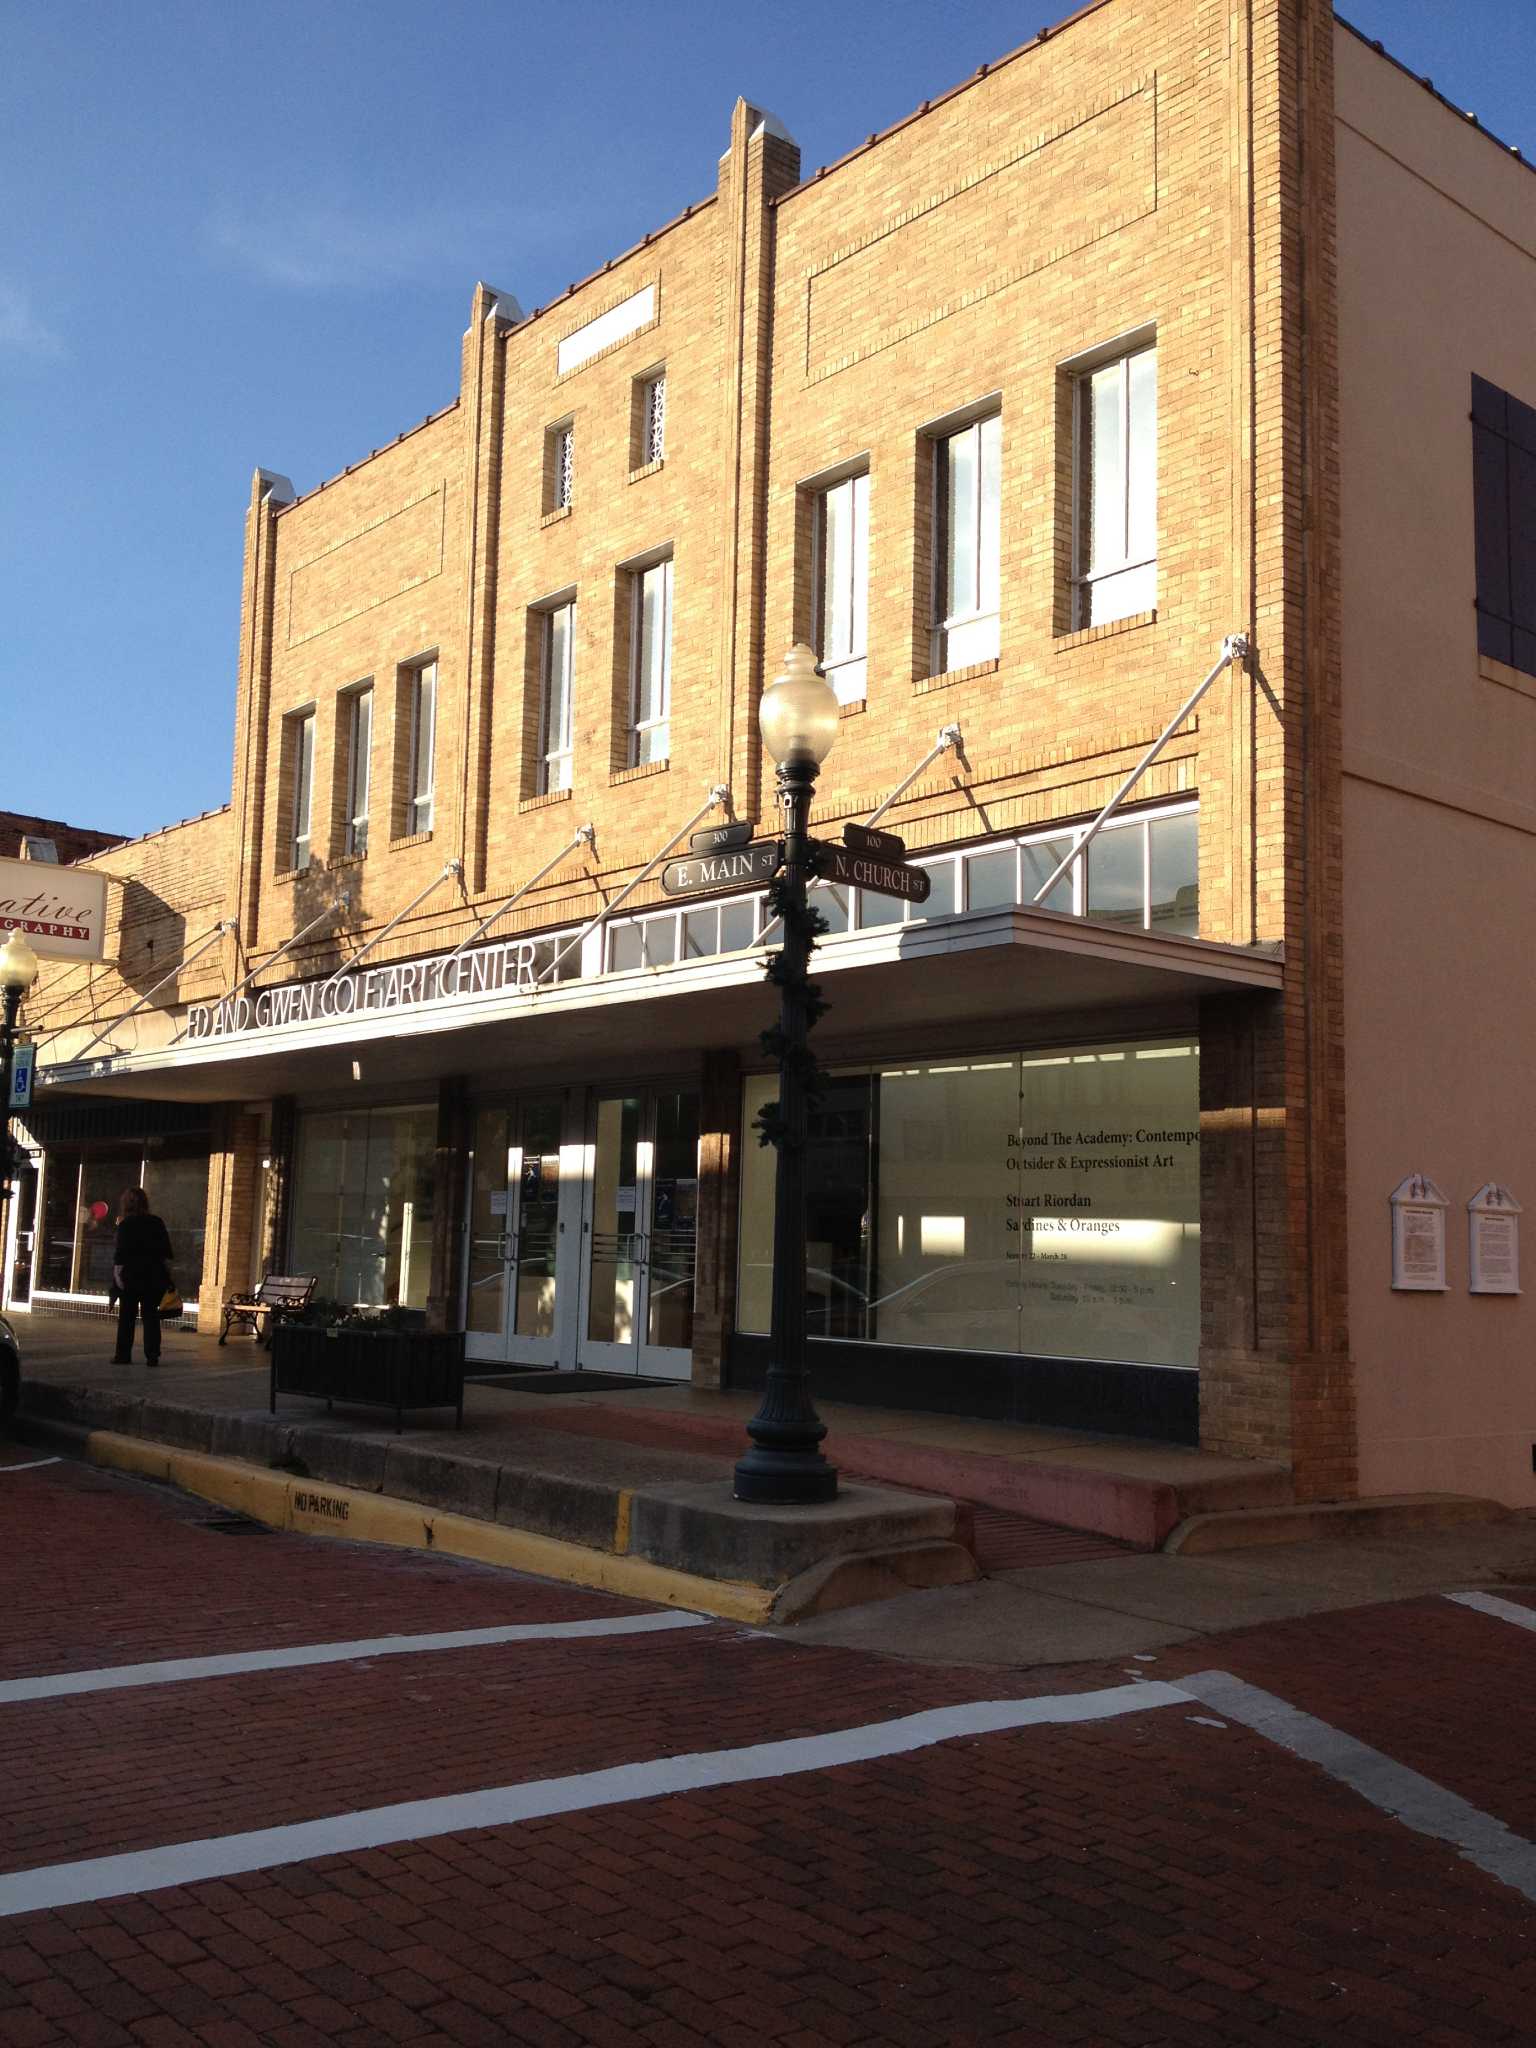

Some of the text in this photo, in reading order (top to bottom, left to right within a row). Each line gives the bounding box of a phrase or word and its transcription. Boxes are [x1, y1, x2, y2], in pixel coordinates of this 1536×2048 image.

[712, 831, 728, 844] 300
[865, 835, 882, 849] 100
[677, 853, 776, 887] E. MAIN ST
[834, 855, 926, 892] N. CHURCH ST
[4, 919, 87, 939] GRAPHY
[187, 941, 537, 1039] ED AND GWEN COLE ART CENTER
[1007, 1132, 1048, 1149] Beyond
[1051, 1132, 1073, 1145] The
[1075, 1130, 1133, 1147] Academy:
[1057, 1156, 1067, 1169] &
[1070, 1154, 1149, 1172] Expressionist
[1153, 1154, 1174, 1168] Art
[1006, 1193, 1091, 1208] Stuart Riordan
[1057, 1217, 1067, 1231] &
[1070, 1217, 1120, 1237] Oranges
[294, 1491, 349, 1520] NO PARKING
